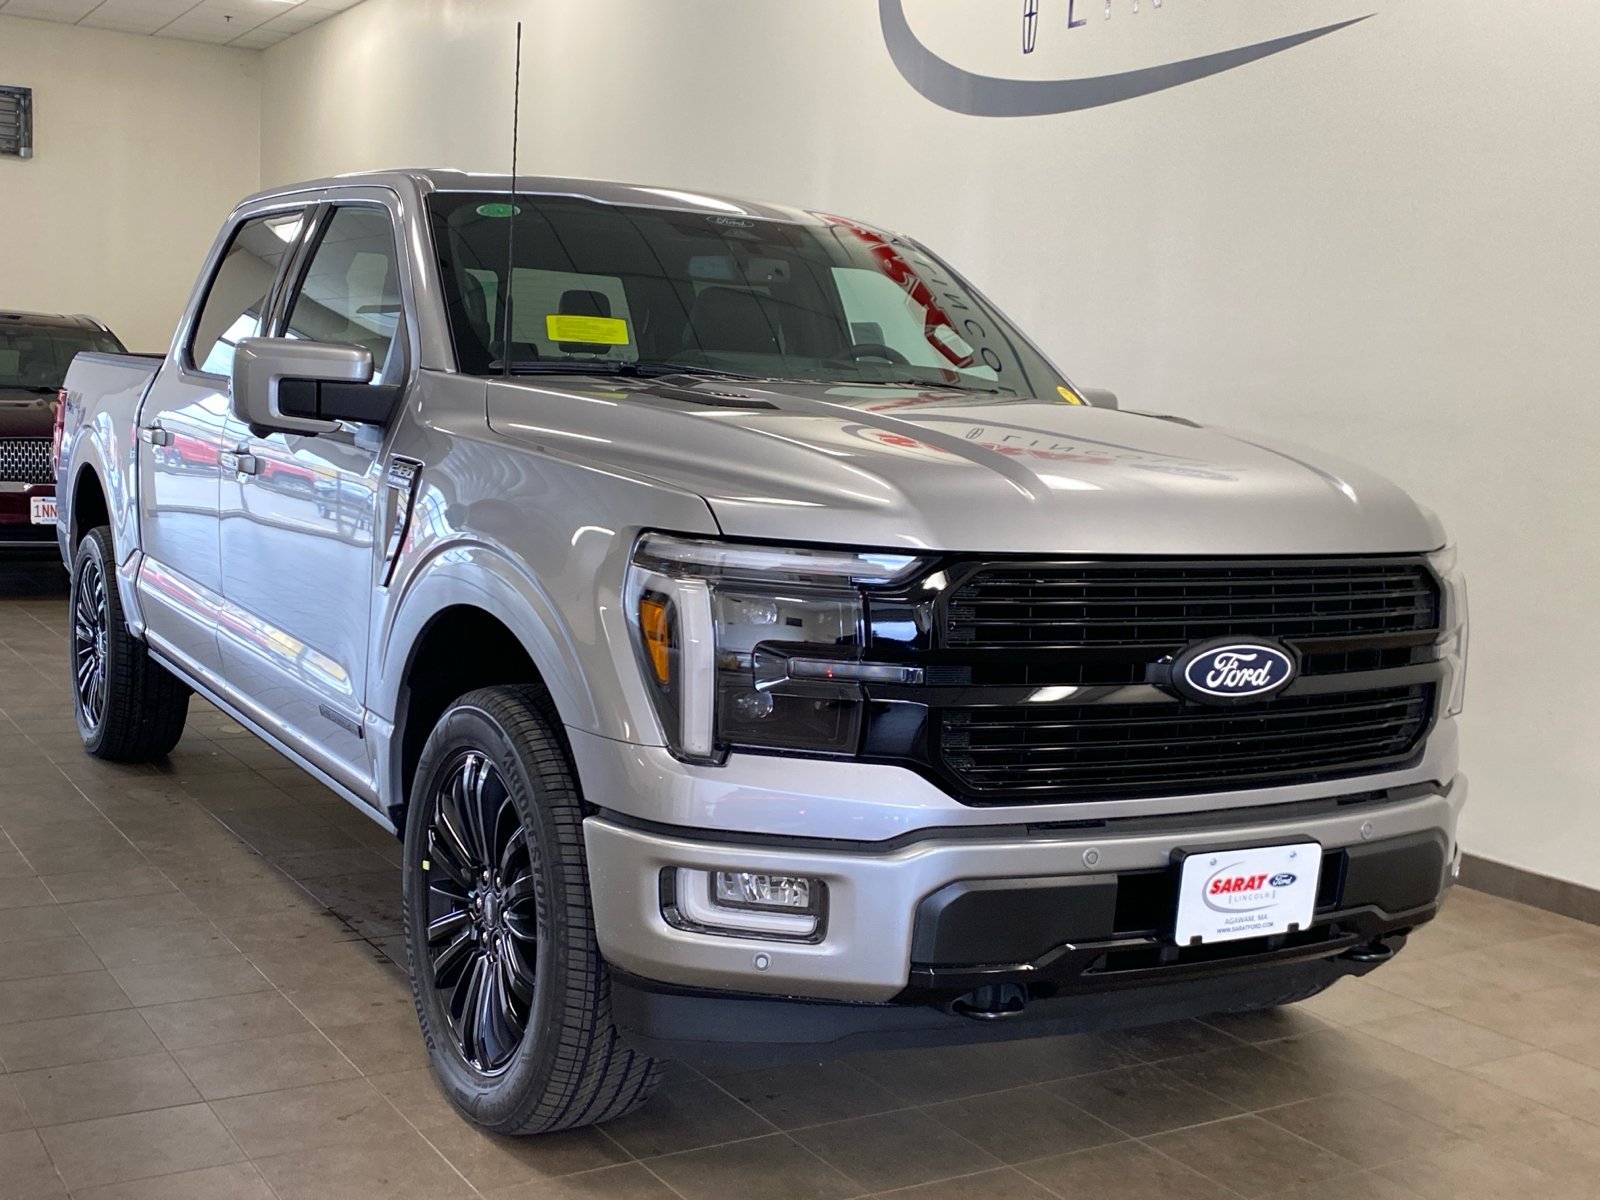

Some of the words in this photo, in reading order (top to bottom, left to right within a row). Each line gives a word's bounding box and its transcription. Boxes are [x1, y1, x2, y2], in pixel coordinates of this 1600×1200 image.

[1206, 652, 1273, 688] Ford
[503, 751, 549, 940] BRIDGESTONE
[1209, 873, 1269, 895] SARAT
[1271, 873, 1294, 887] Ford
[1234, 892, 1270, 903] LINCOLN
[1216, 921, 1275, 934] WWW.SARATFORD.COM
[1224, 915, 1256, 926] AGAWAM,
[1257, 913, 1268, 921] MA
